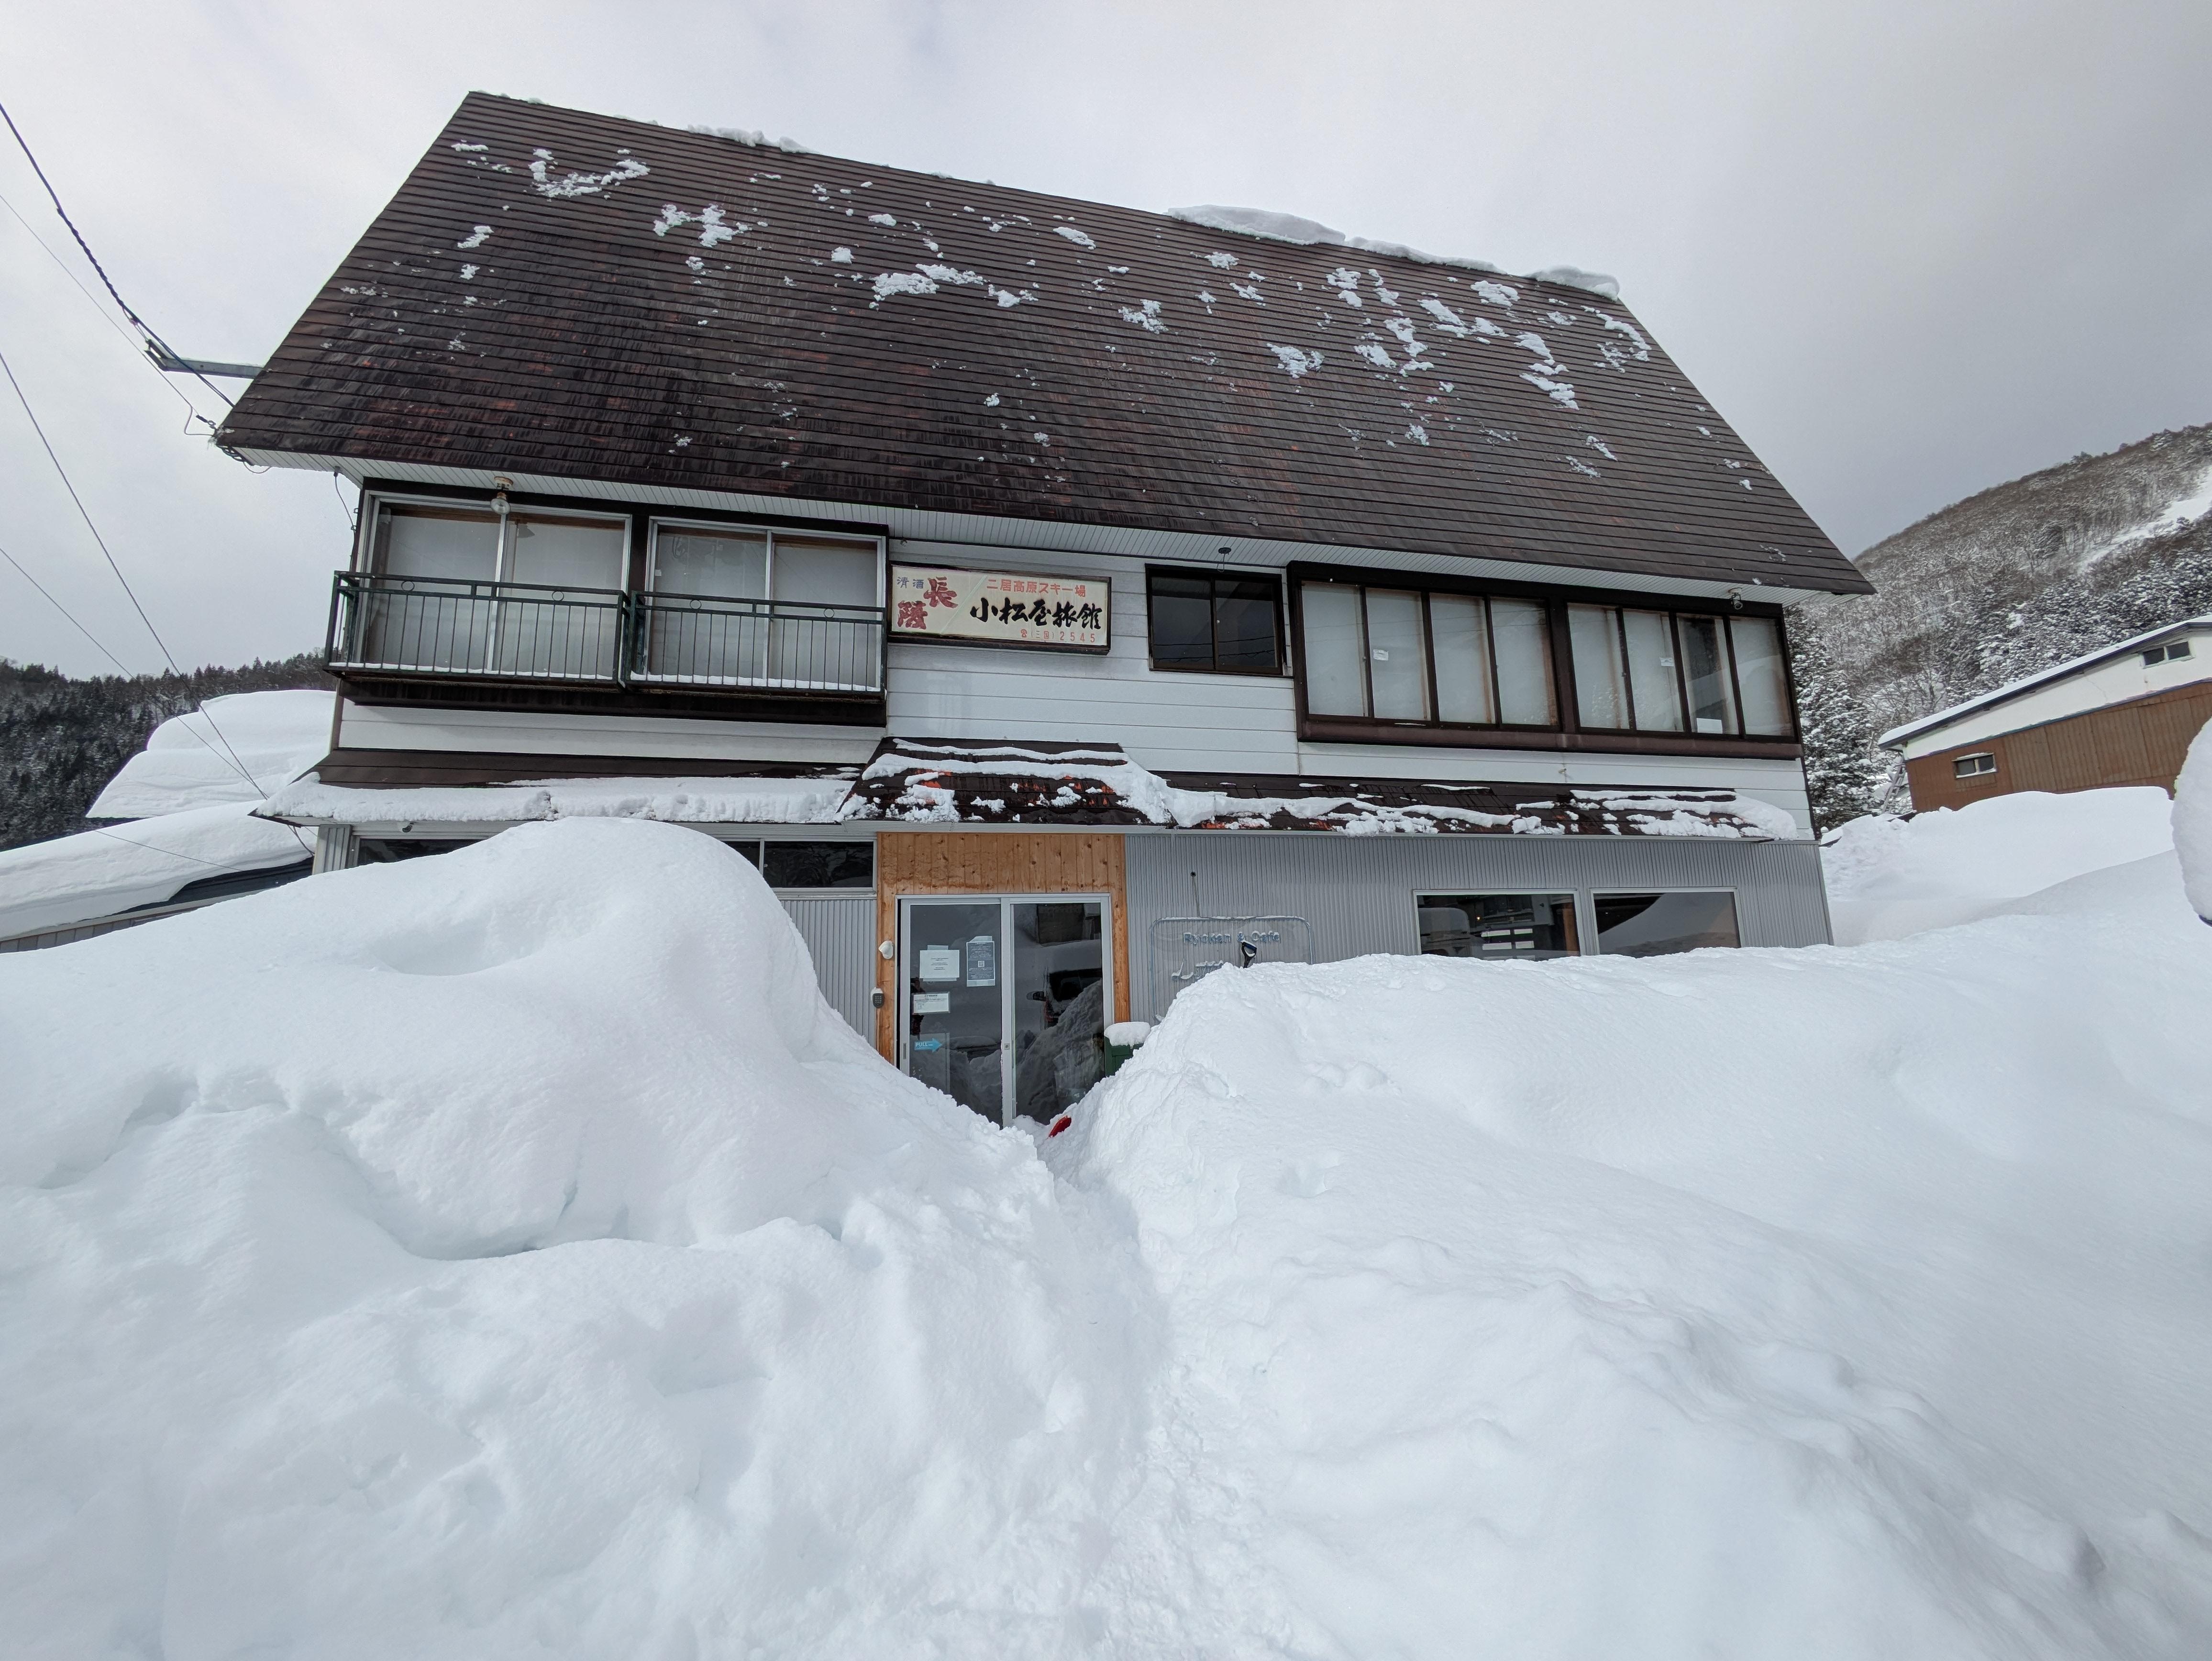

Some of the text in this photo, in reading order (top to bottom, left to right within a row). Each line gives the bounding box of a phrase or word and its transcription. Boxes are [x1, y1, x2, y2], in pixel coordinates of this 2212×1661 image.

[897, 576, 924, 589] 清酒
[986, 579, 1086, 598] 二居高原スキー場
[970, 598, 1103, 630] 小松屋旅館
[1183, 932, 1231, 944] Ryokan
[1237, 931, 1245, 942] &
